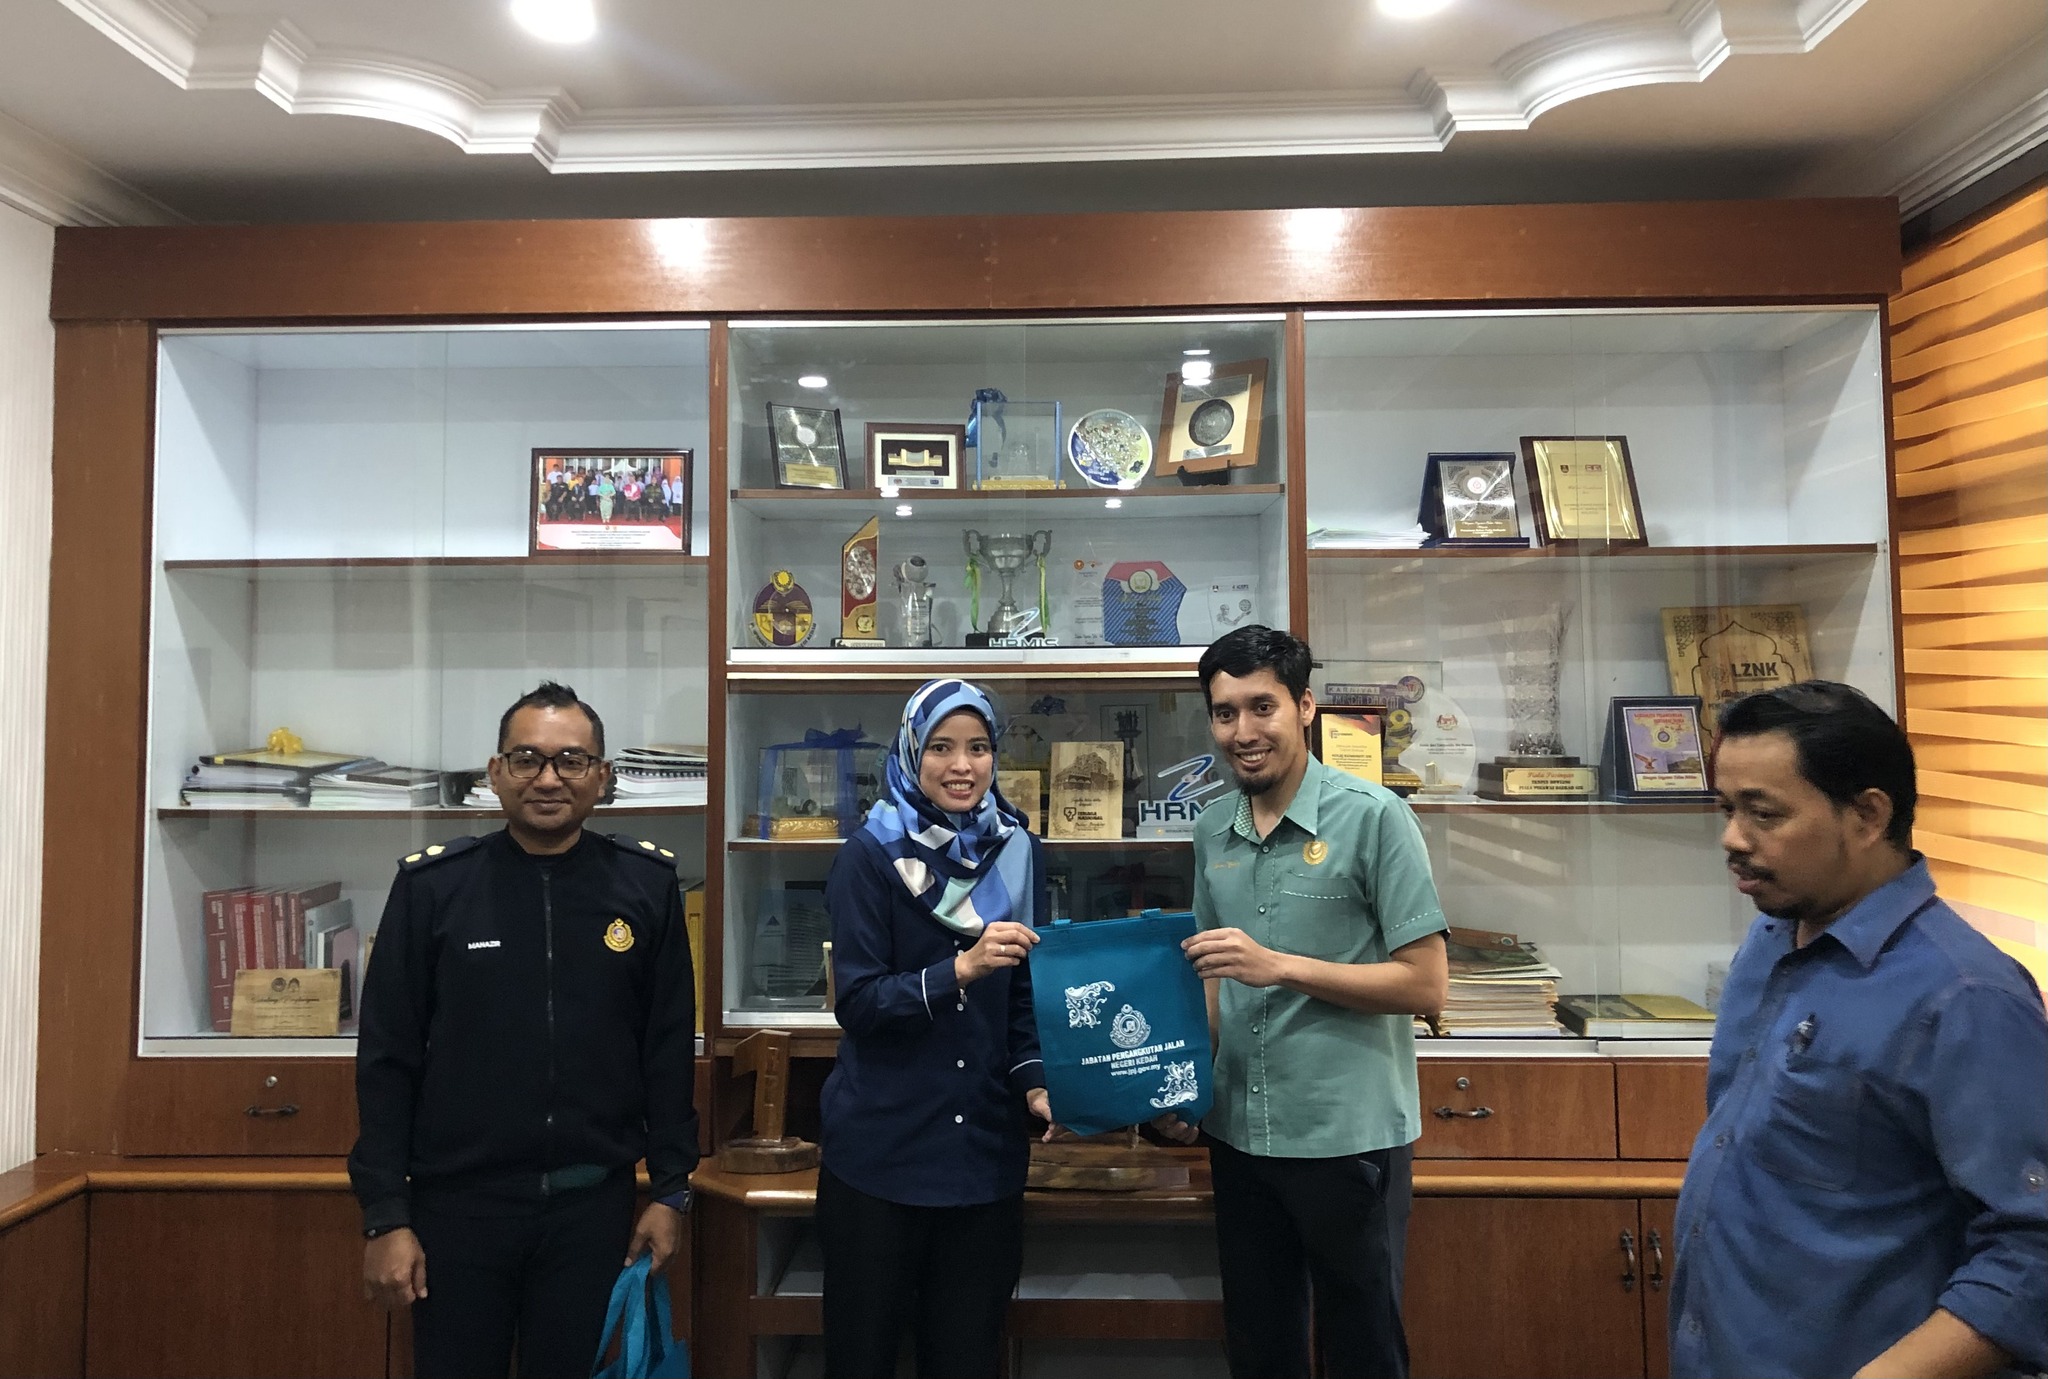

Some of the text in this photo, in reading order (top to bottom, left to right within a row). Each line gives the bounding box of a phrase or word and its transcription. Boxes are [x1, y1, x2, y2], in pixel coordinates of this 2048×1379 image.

[1731, 662, 1778, 677] LZNK
[1081, 1039, 1185, 1066] JABATAN PENGANGKUTAN JALAN
[1110, 1054, 1159, 1070] NEGERI KEDAH
[1110, 1063, 1161, 1076] www.jpj.gov.my
